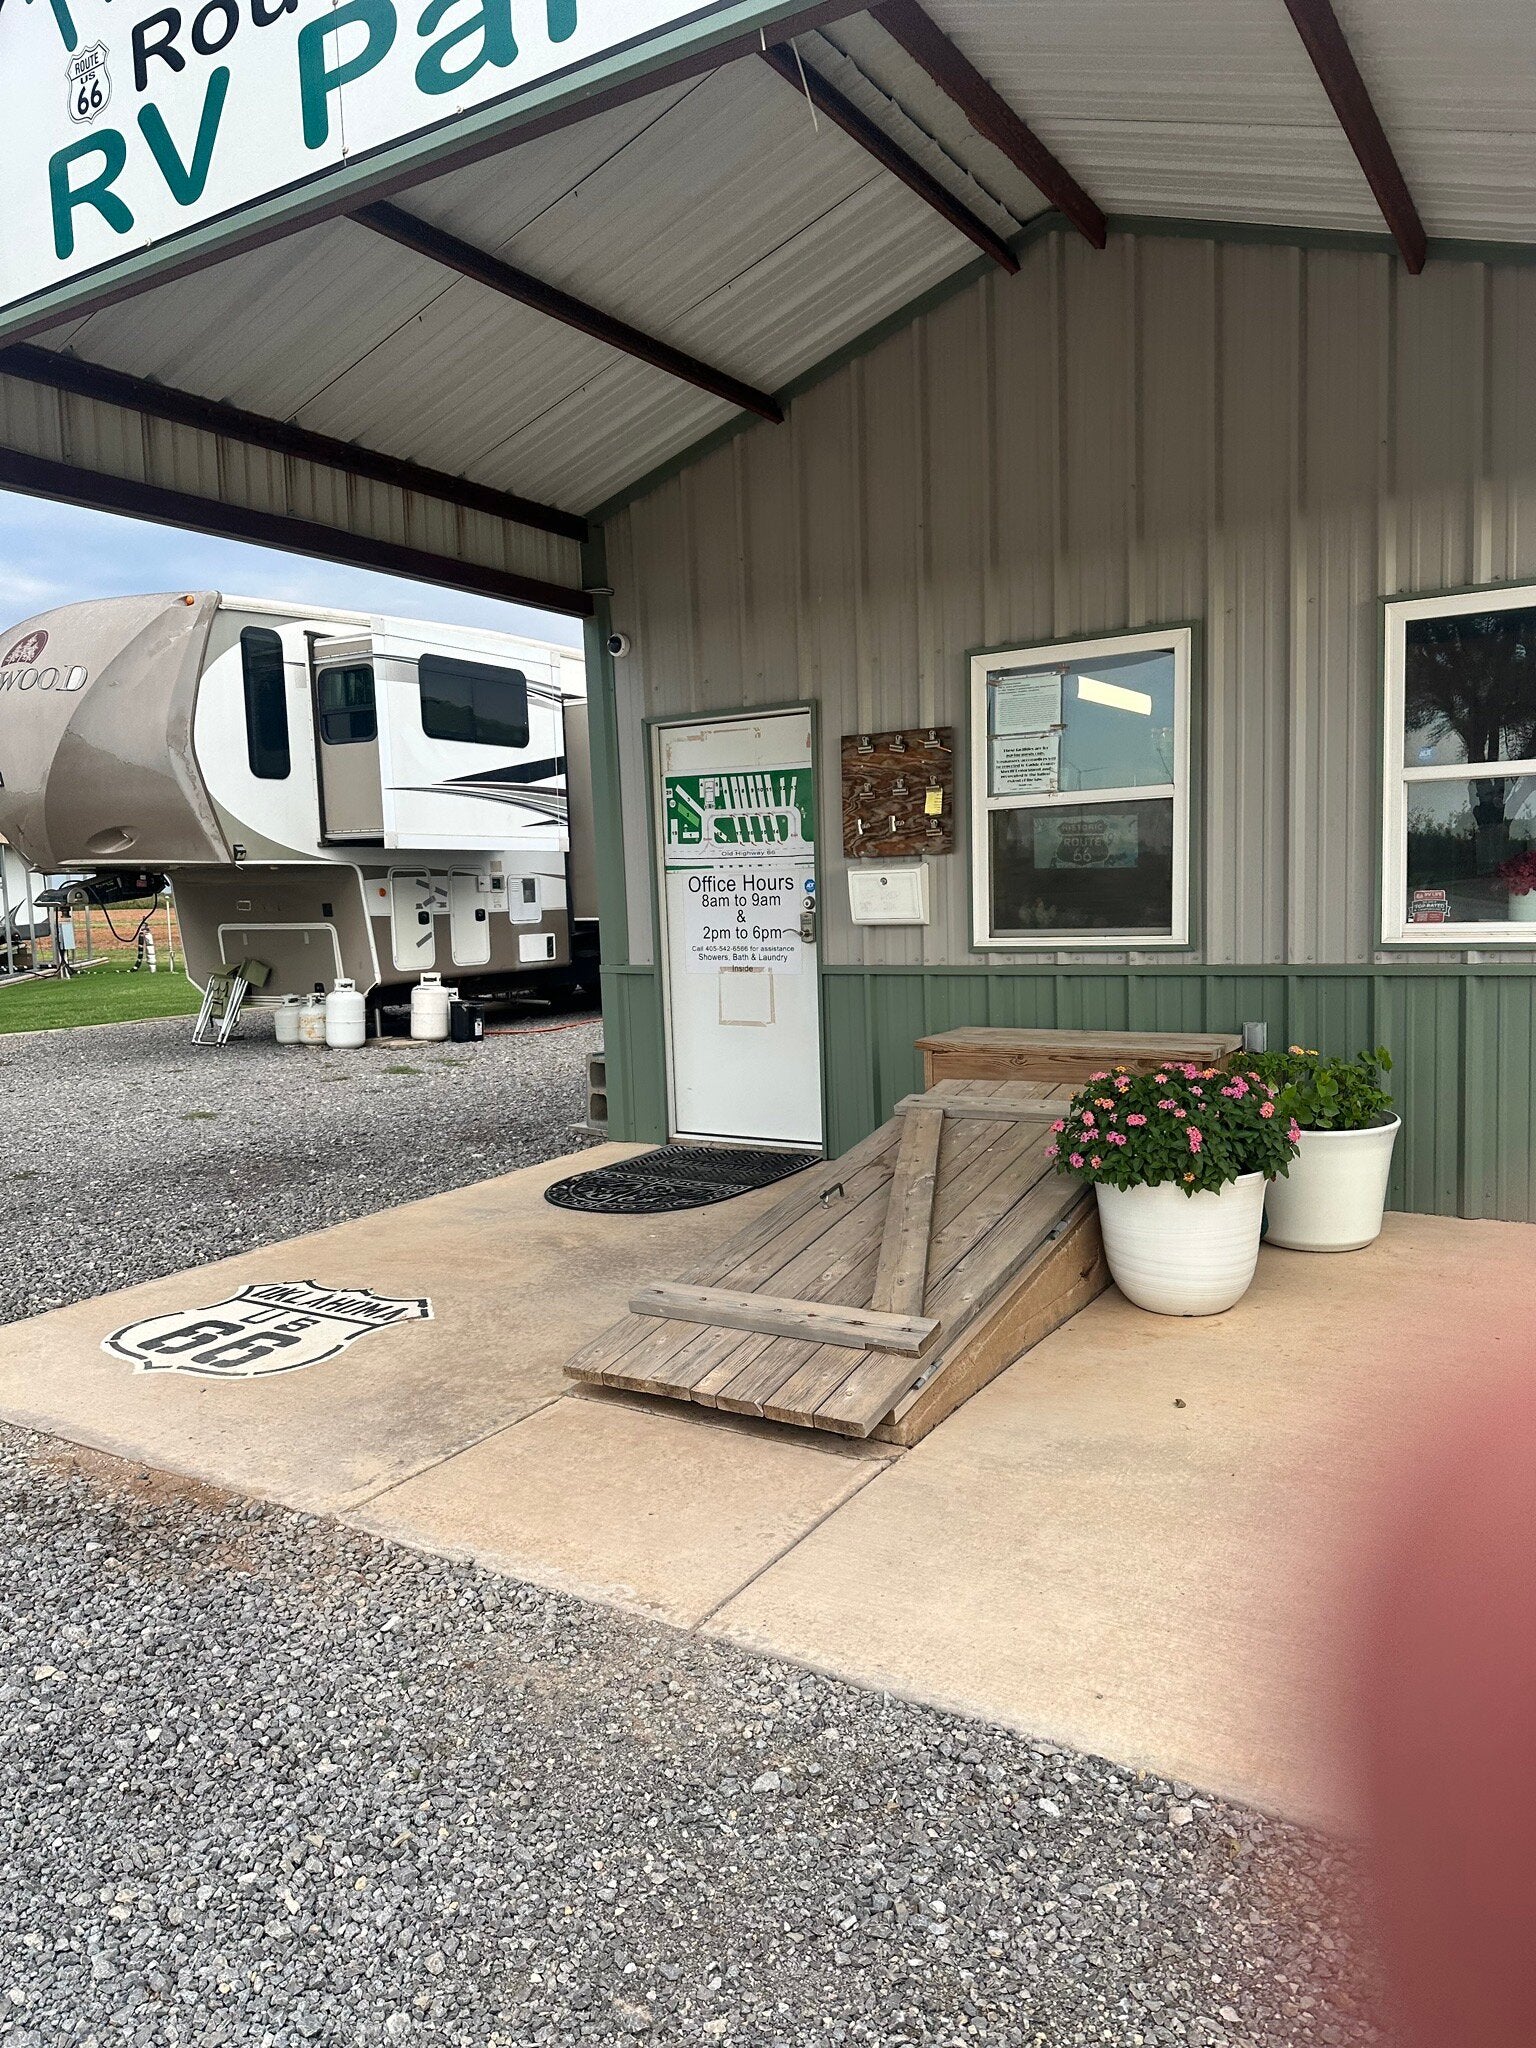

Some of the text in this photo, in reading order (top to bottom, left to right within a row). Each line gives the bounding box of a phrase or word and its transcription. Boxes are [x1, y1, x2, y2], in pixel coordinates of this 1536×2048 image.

[75, 52, 99, 75] ROUTE
[80, 71, 96, 84] US
[77, 79, 103, 115] 66
[49, 66, 230, 260] RV
[735, 850, 765, 858] Highway
[688, 875, 794, 893] Office Hours
[702, 892, 781, 907] 8am to 9am
[736, 909, 747, 923] &
[703, 925, 782, 942] 2pm to 6pm
[732, 953, 749, 961] Bath
[750, 953, 756, 961] &
[758, 953, 788, 963] Laundry
[250, 1286, 409, 1321] OKLAHOMA
[239, 1308, 321, 1332] US
[136, 1319, 302, 1368] 66
